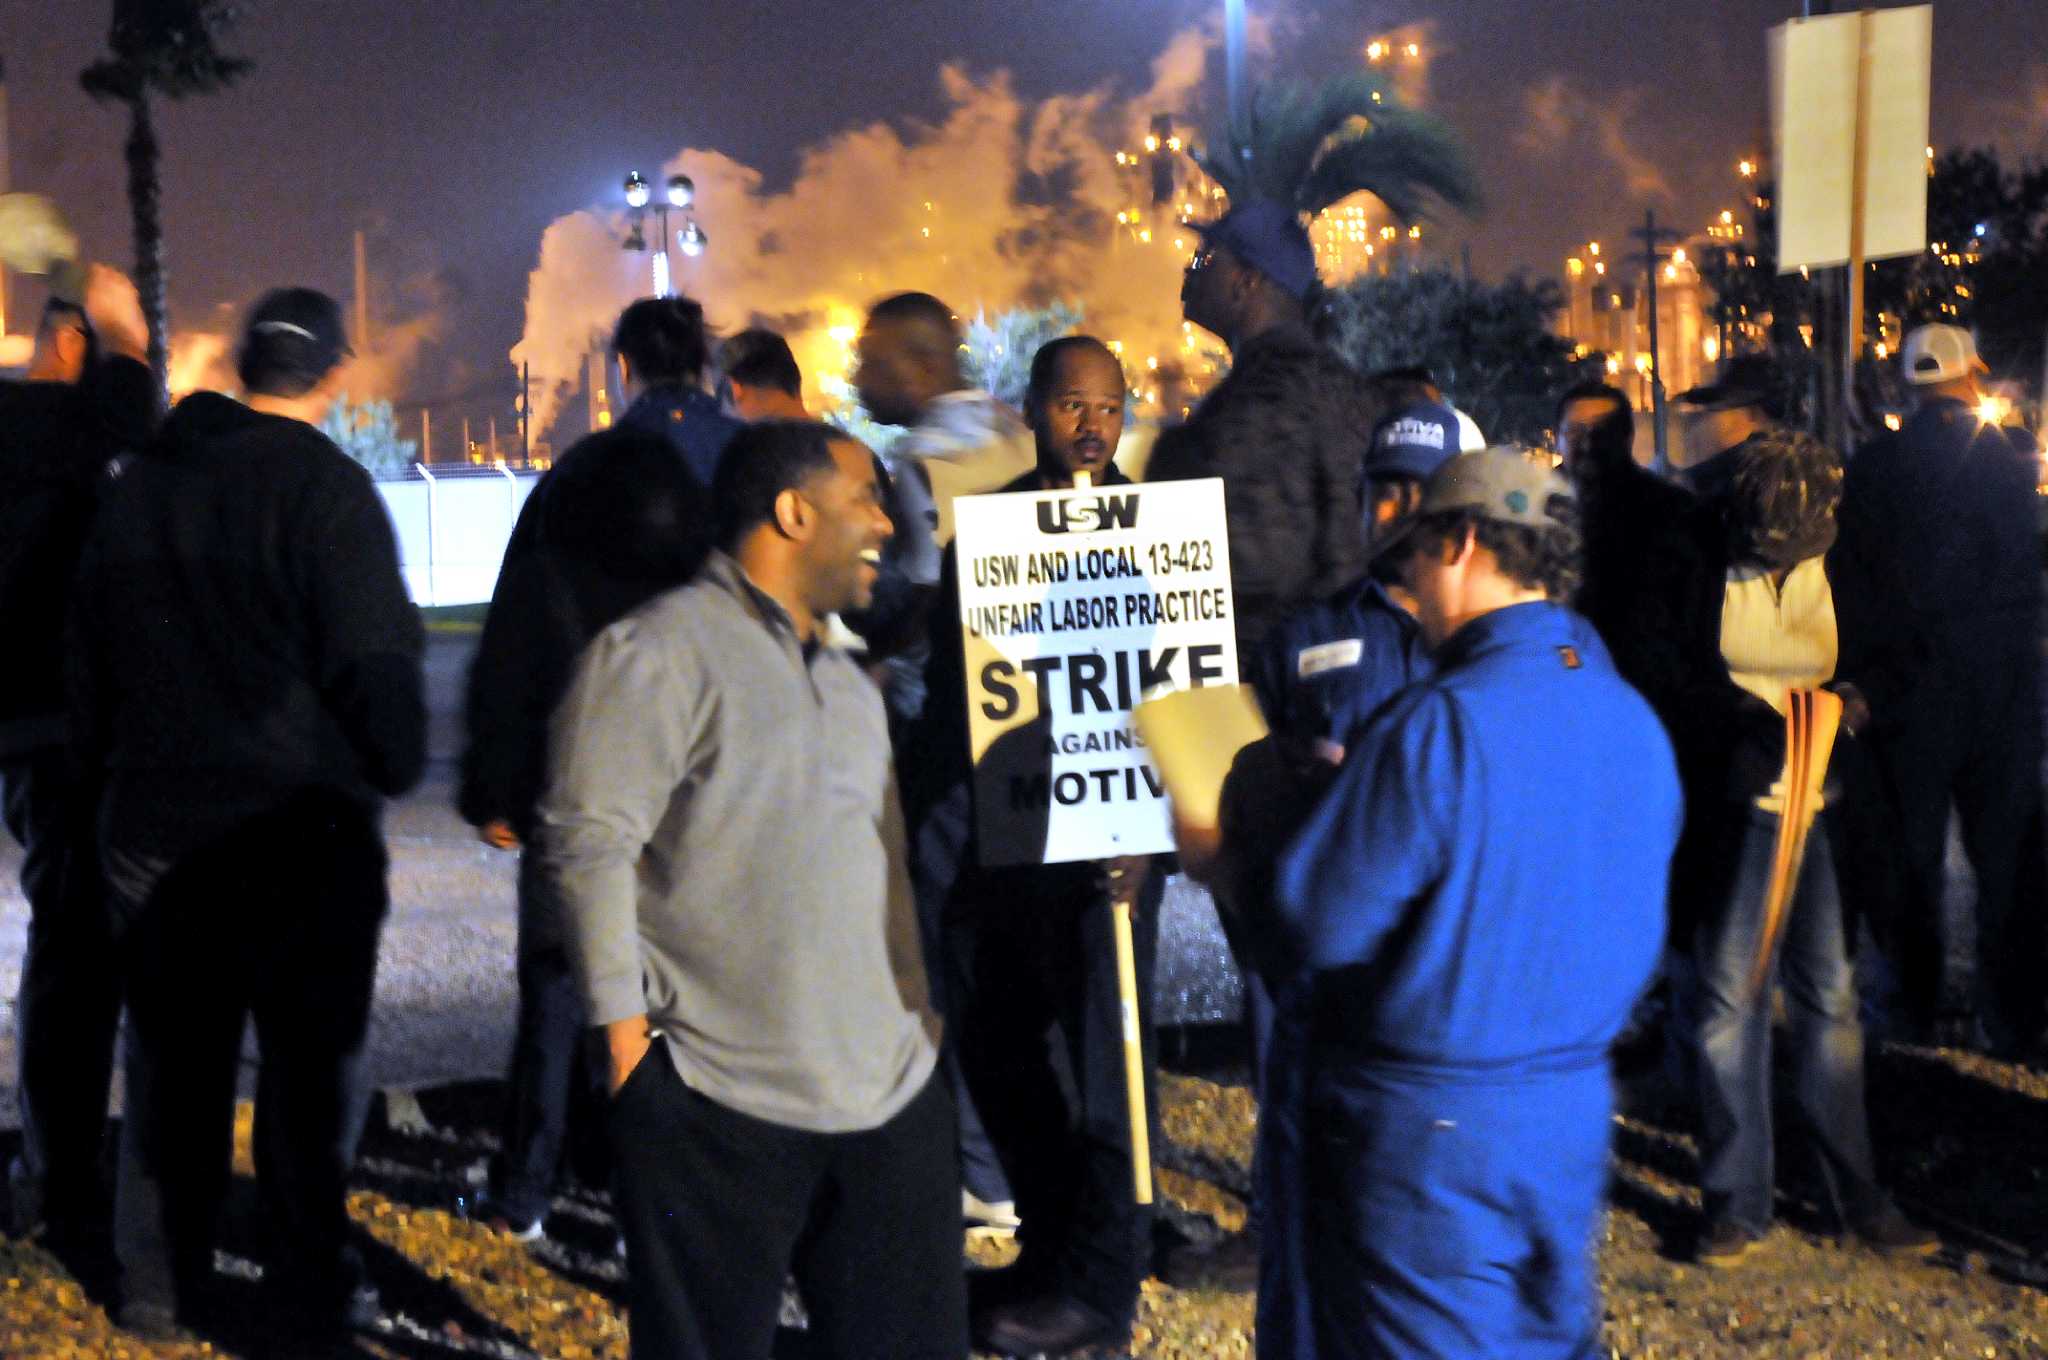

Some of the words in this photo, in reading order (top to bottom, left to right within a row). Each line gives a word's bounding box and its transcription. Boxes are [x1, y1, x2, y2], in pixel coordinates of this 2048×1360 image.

[1036, 494, 1140, 534] USW
[973, 554, 1020, 588] USW
[1026, 550, 1069, 584] AND
[1075, 545, 1143, 580] LOCAL
[1148, 539, 1214, 577] 13-423
[968, 602, 1044, 638] UNFAIR
[1050, 597, 1120, 632] LABOR
[1125, 588, 1227, 626] PRACTICE
